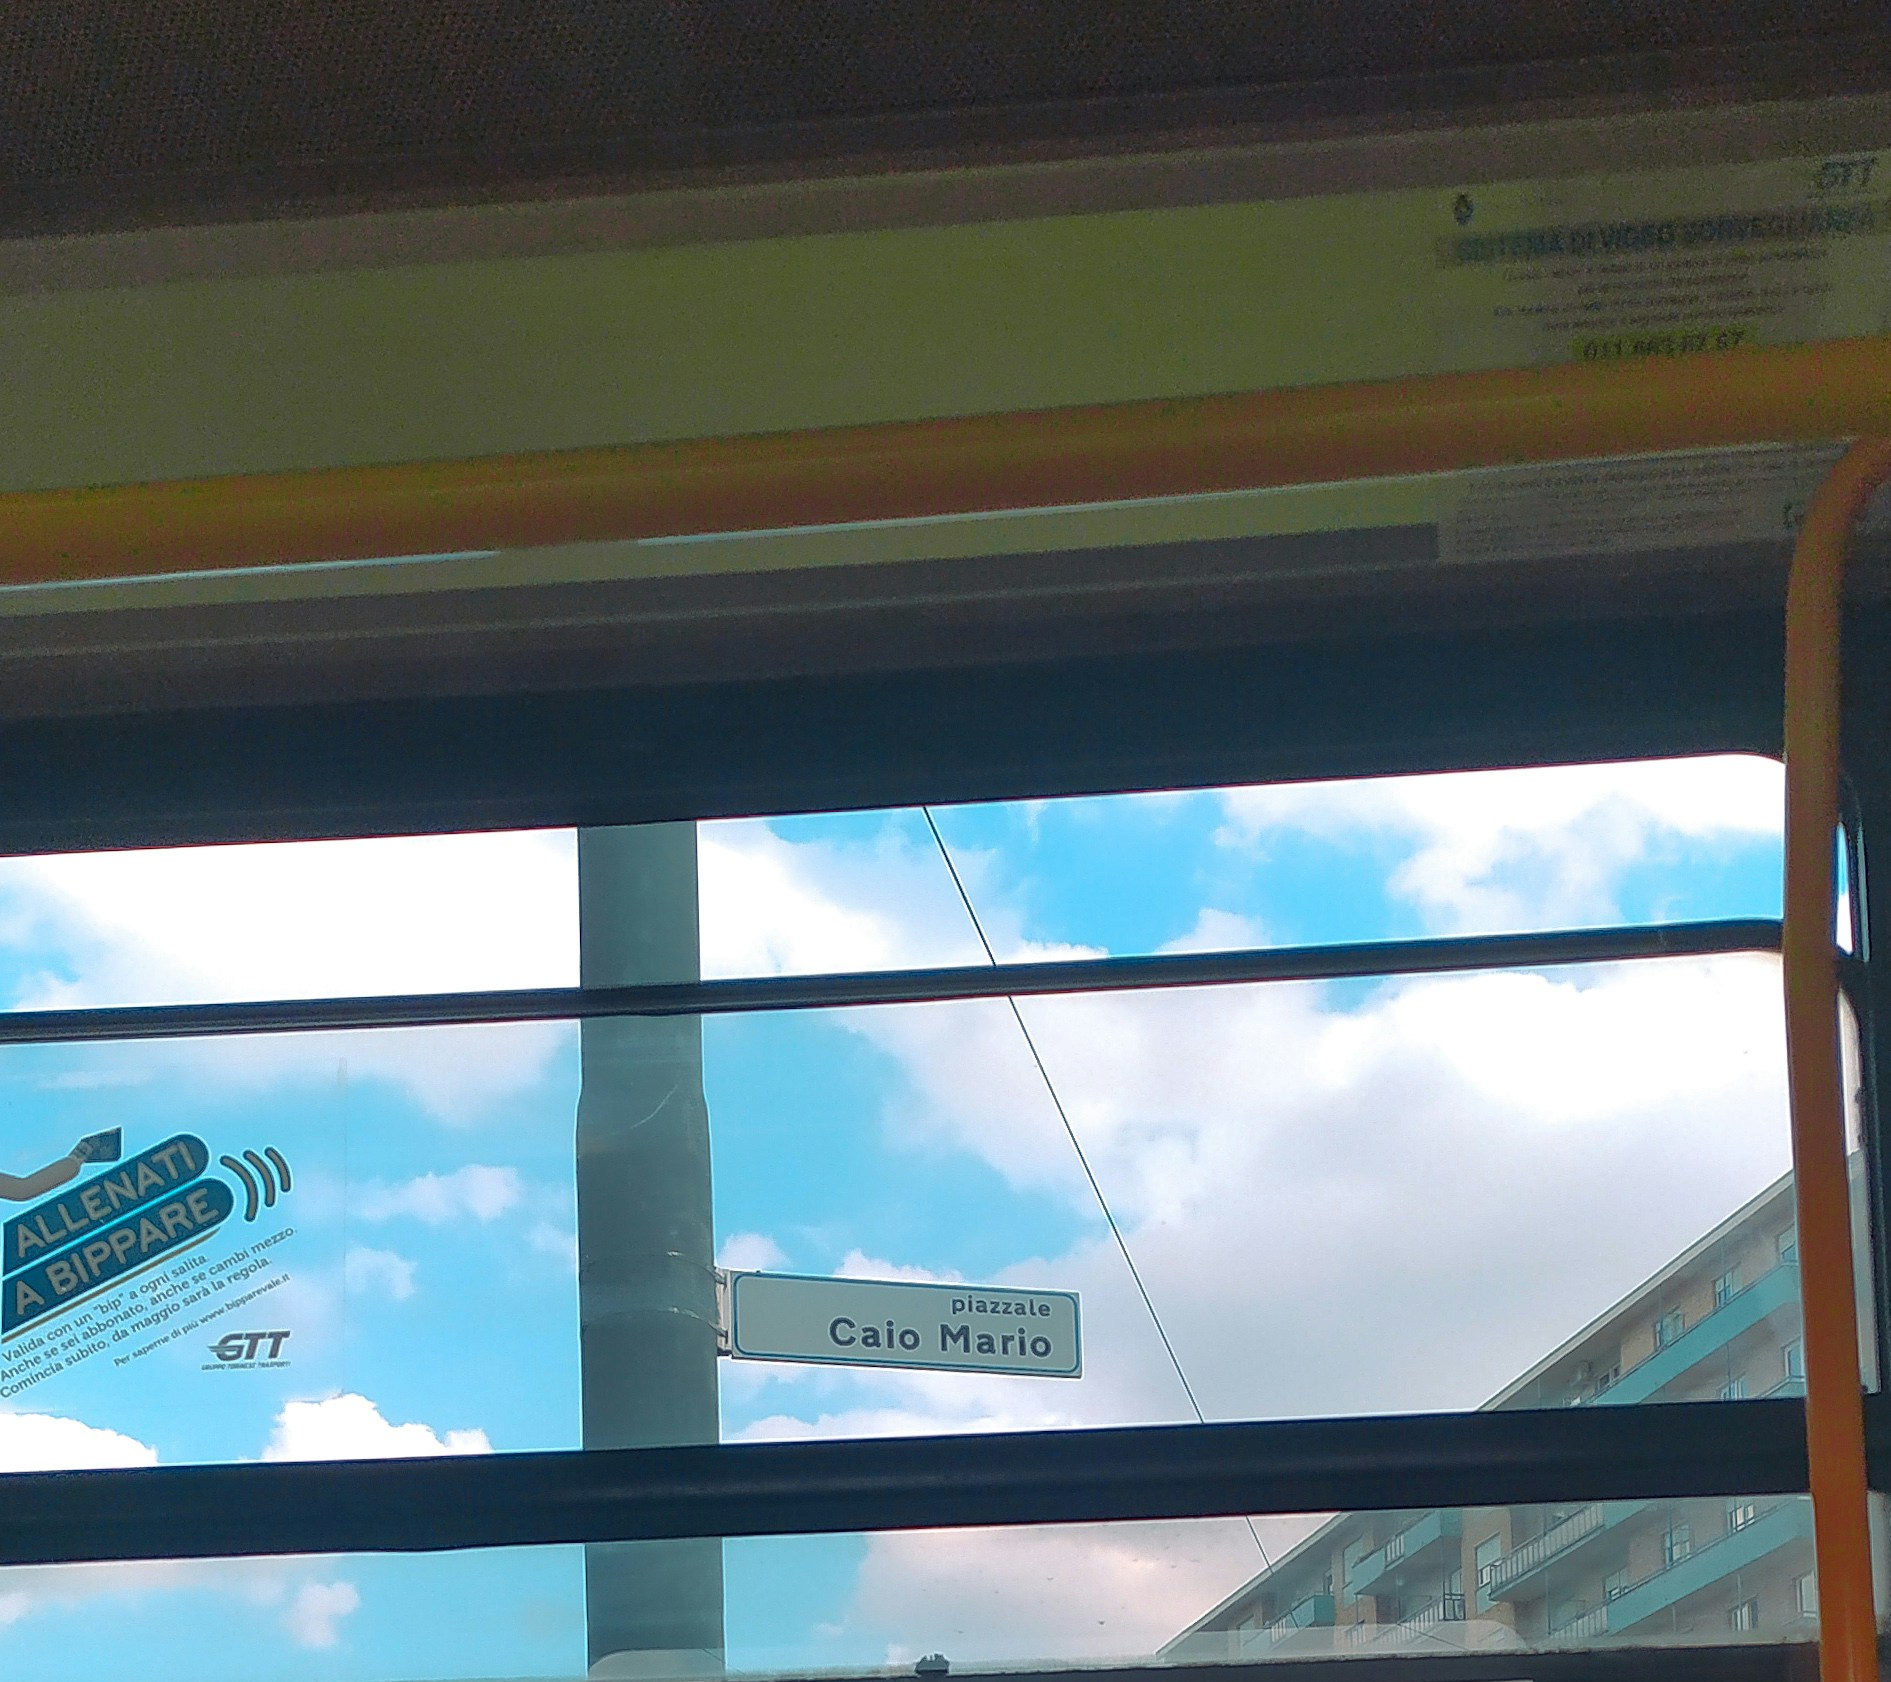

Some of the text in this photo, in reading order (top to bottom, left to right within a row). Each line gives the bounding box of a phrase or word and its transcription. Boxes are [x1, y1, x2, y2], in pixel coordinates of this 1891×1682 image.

[16, 1141, 195, 1258] ALLENATI
[16, 1187, 220, 1315] A BIPPARE
[0, 1227, 298, 1382] Anche se sei abbonato, anche se cambi mezzo.
[0, 1257, 273, 1398] Comincia subito, da maggio sarà la regola.
[2, 1336, 45, 1362] Valida
[47, 1323, 73, 1341] con
[74, 1313, 93, 1328] un
[129, 1290, 138, 1300] a
[139, 1272, 171, 1293] ogni
[113, 1354, 130, 1367] Per
[170, 1328, 182, 1340] di
[181, 1320, 199, 1335] più
[208, 1330, 291, 1362] GTT
[828, 1316, 1052, 1358] Caio Mario
[951, 1294, 1051, 1317] piazzale
